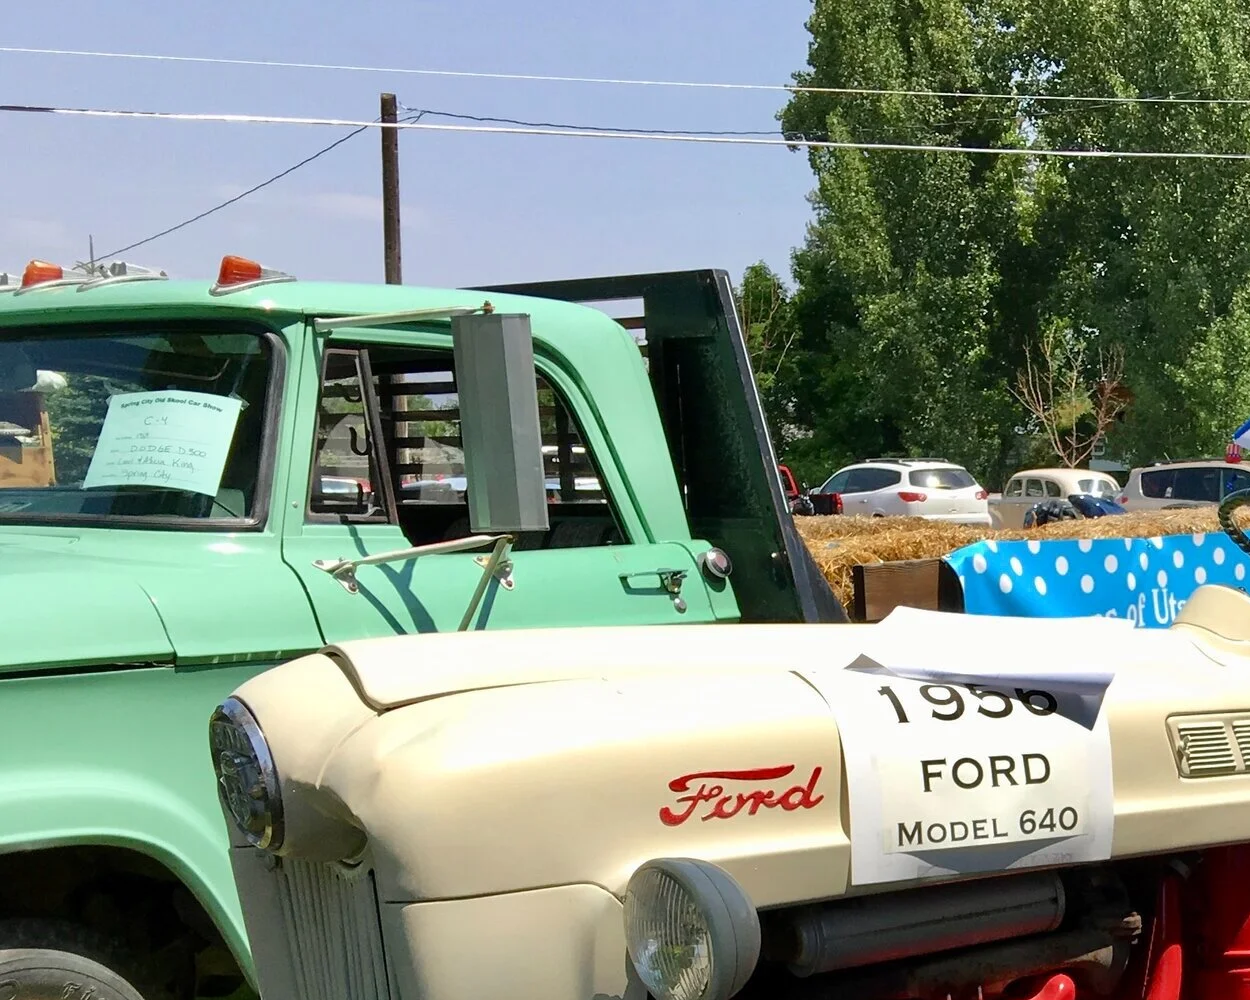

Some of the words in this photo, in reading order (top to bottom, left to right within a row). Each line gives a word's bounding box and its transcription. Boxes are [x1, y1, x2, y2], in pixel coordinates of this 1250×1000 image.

[120, 400, 140, 409] Spring
[188, 399, 201, 407] Car
[202, 402, 223, 413] Show
[130, 445, 173, 453] DODGE
[877, 683, 1058, 723] 1956
[919, 752, 1051, 793] FORD
[659, 764, 825, 827] Ford
[896, 817, 1009, 847] MODEL
[1018, 806, 1079, 834] 640
